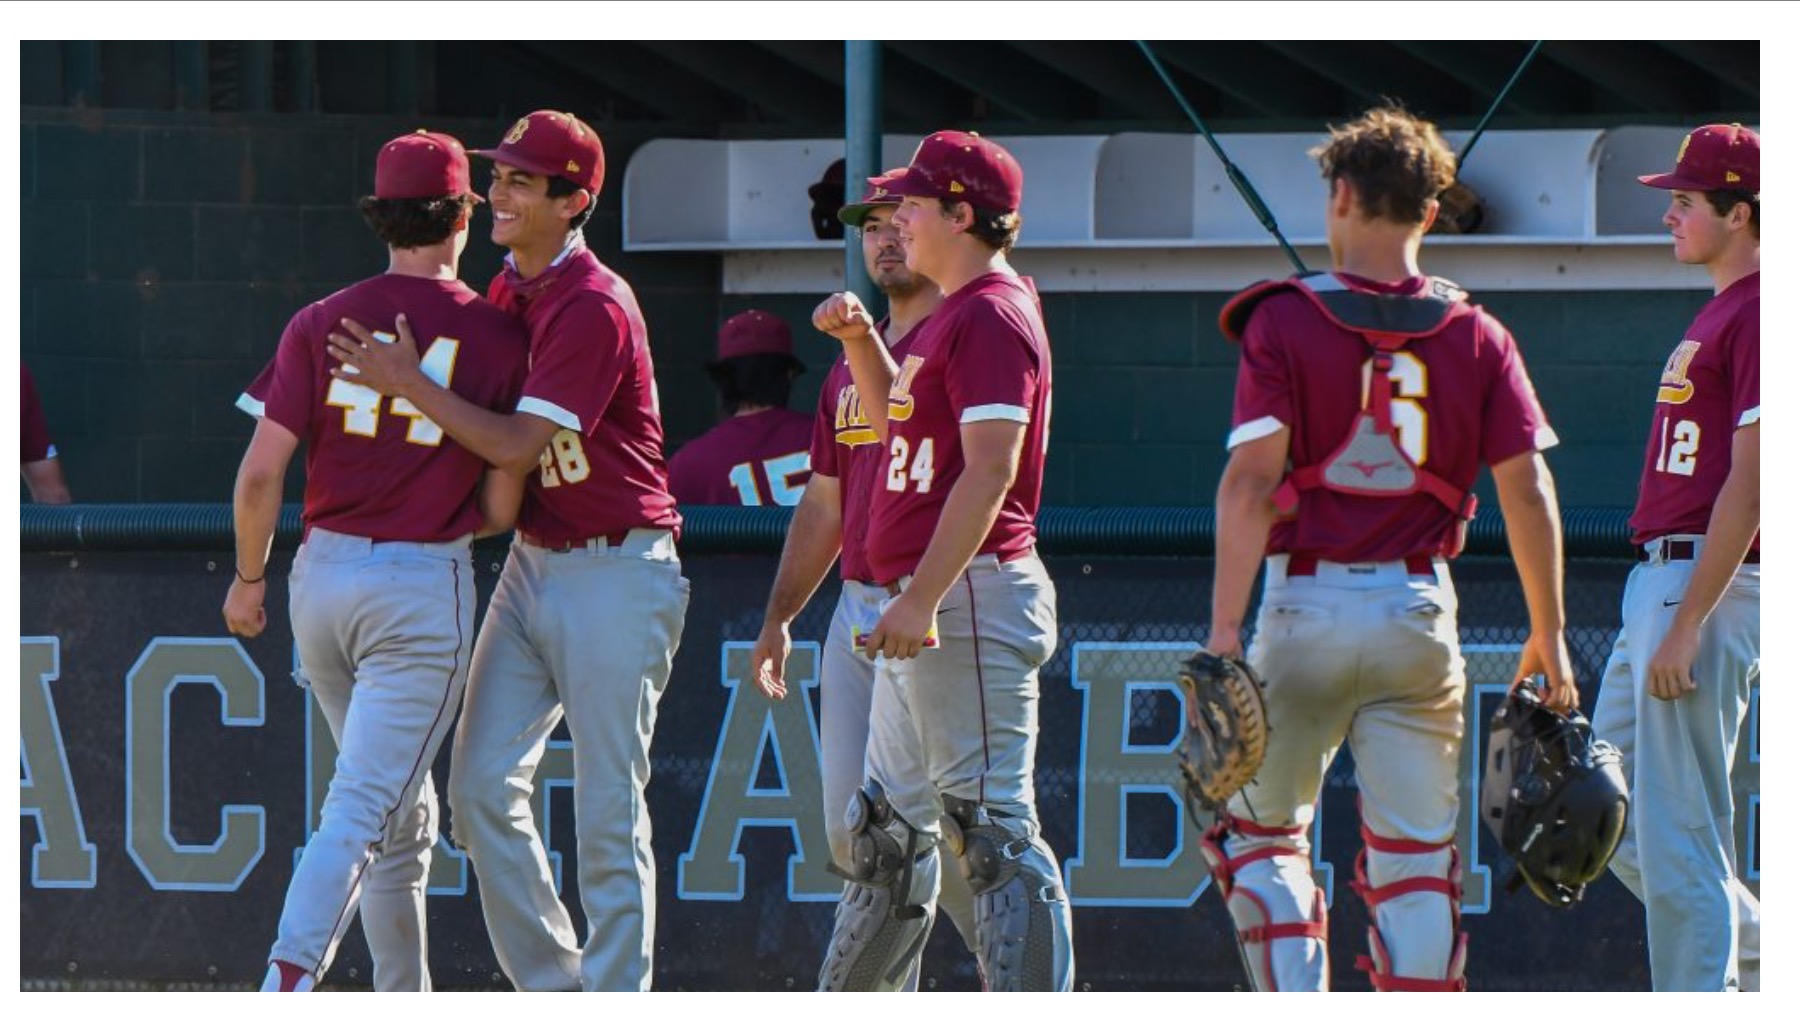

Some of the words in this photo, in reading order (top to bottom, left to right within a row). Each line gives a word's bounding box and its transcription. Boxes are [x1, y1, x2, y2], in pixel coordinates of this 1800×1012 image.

[886, 435, 935, 493] 24
[1656, 417, 1701, 476] 12
[729, 450, 811, 506] 15
